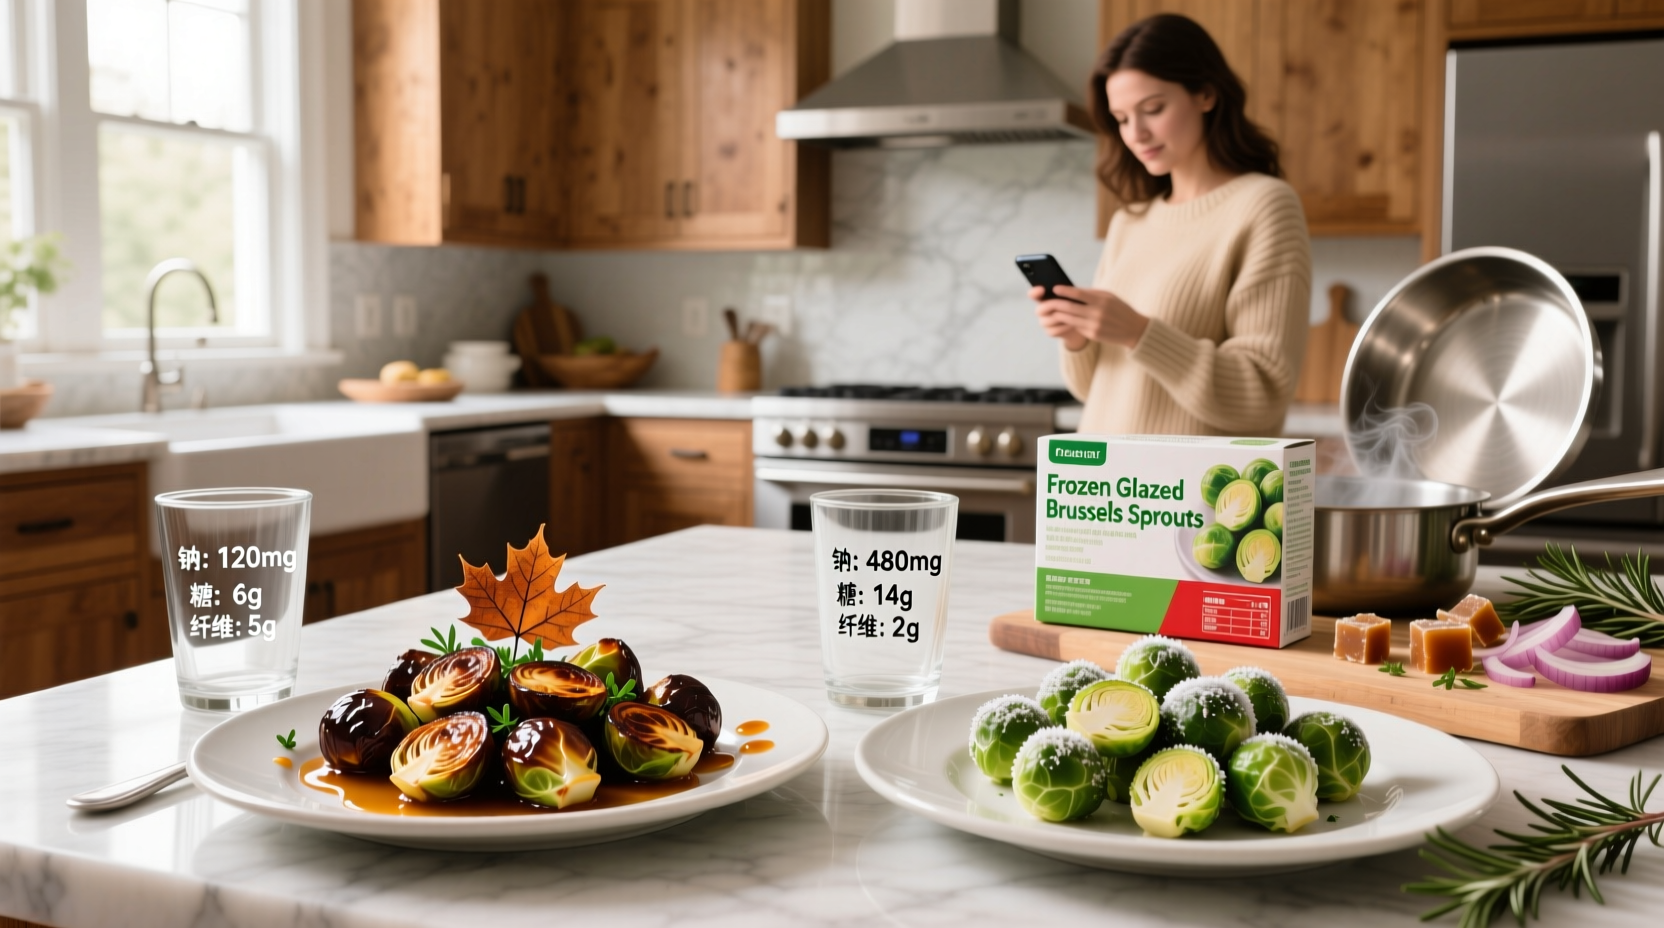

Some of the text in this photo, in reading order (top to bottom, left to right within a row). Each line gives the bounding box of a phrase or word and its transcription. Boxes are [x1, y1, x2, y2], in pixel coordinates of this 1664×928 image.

[1047, 473, 1184, 501] Frozen Glazed
[1046, 498, 1204, 530] Brussels Sprouts
[218, 546, 297, 573] 120mg
[866, 550, 942, 577] 480mg
[232, 583, 263, 610] 6g
[873, 584, 913, 611] 14g
[248, 614, 277, 642] 5g
[892, 616, 920, 643] 2g
